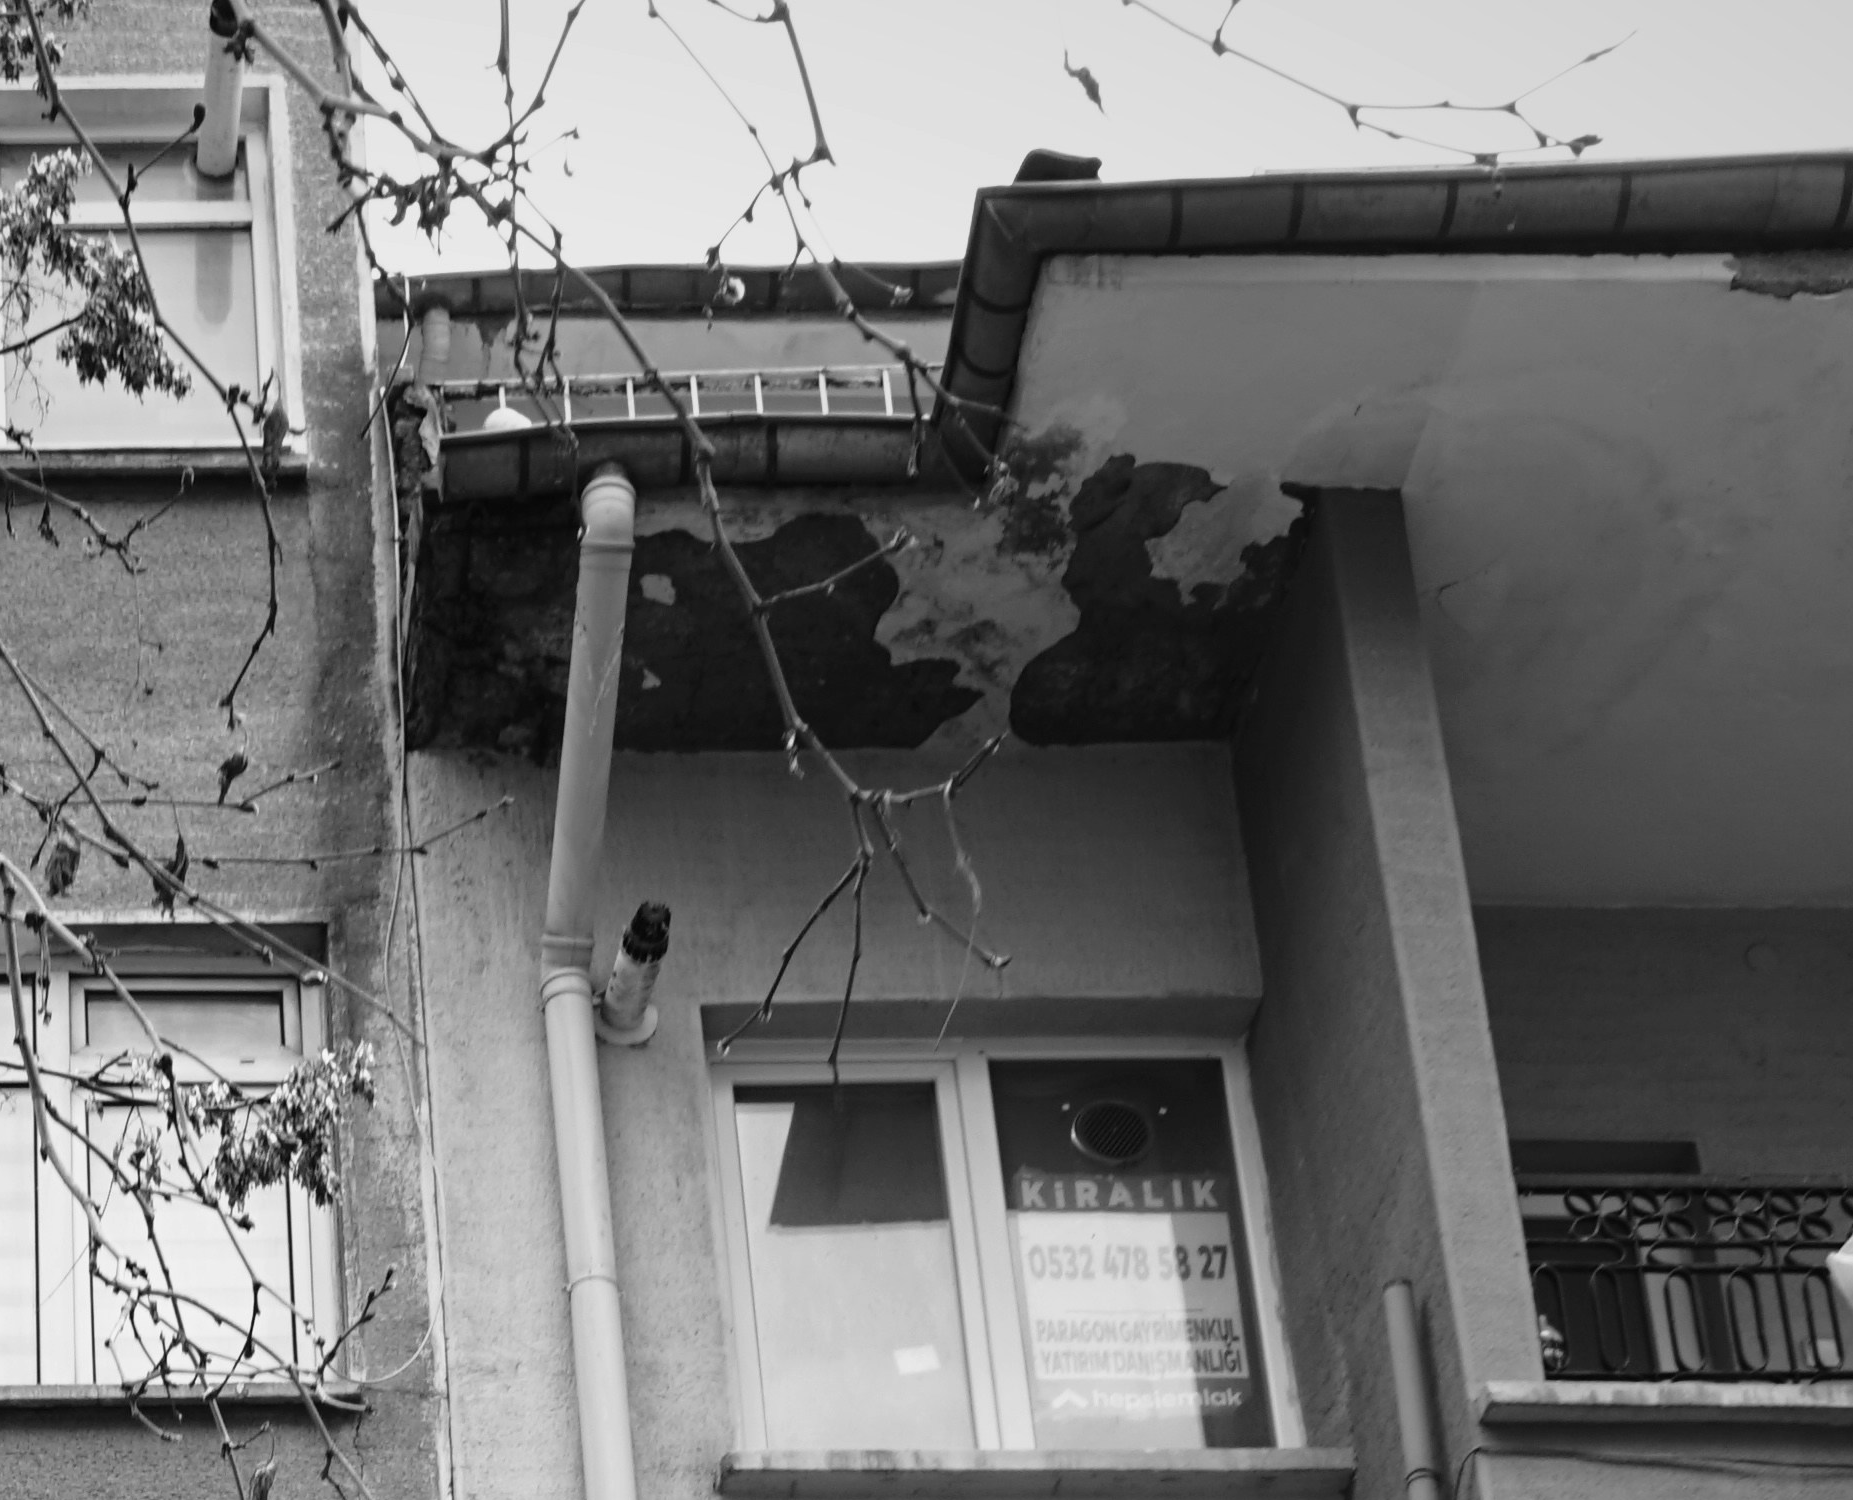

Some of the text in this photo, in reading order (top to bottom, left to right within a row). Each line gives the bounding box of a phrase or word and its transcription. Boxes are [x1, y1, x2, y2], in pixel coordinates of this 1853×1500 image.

[1028, 1244, 1228, 1281] 0532 478 58 27
[1091, 1387, 1243, 1411] hepsiemlak
